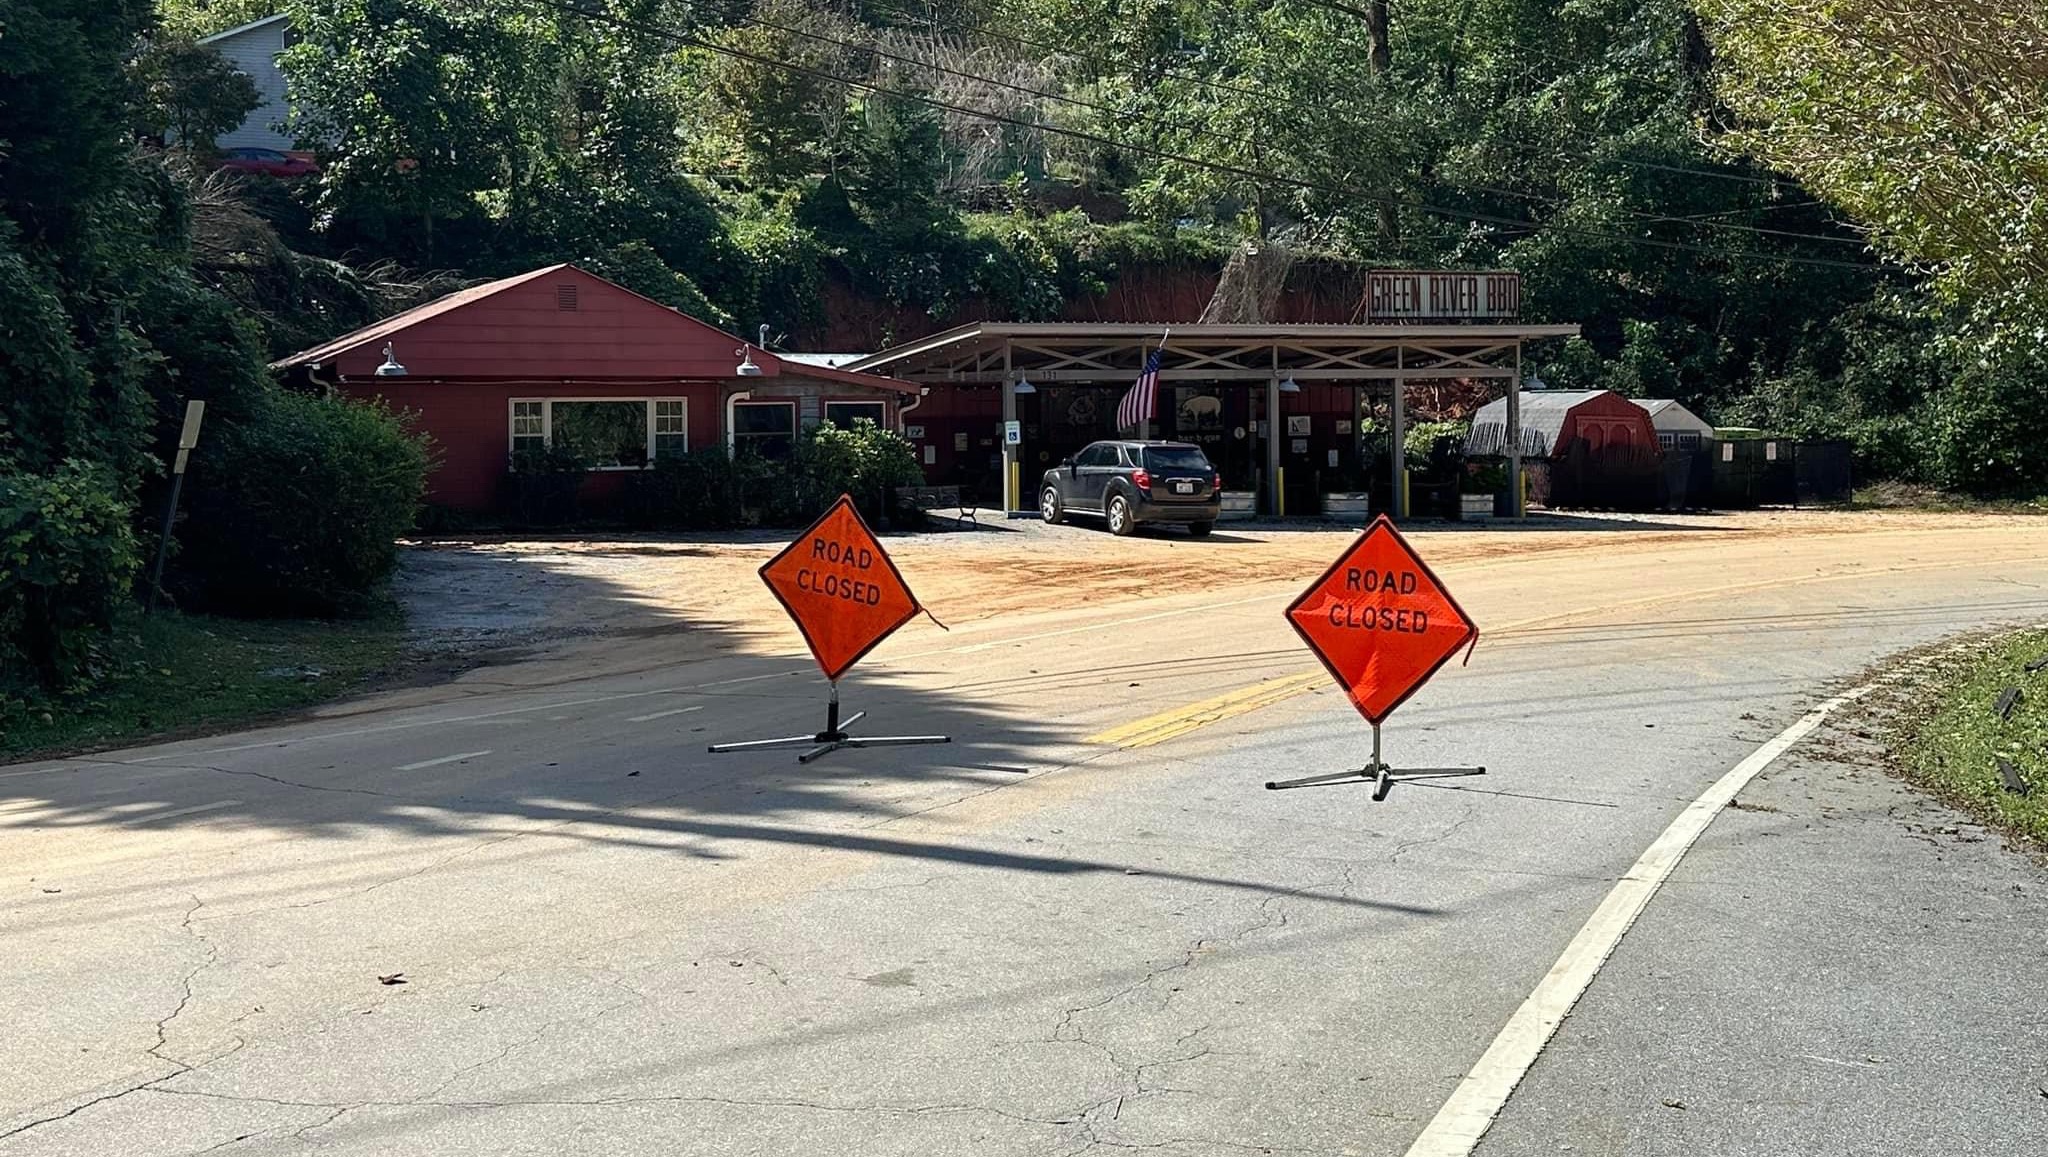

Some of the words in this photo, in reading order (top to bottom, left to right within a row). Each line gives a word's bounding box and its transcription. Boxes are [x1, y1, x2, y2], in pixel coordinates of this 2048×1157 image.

[1372, 278, 1420, 312] GREEN
[1430, 278, 1478, 312] RIVER
[1487, 278, 1517, 315] BBQ
[812, 538, 872, 569] ROAD
[797, 569, 880, 605] CLOSED
[1346, 568, 1416, 594] ROAD
[1329, 604, 1427, 633] CLOSED
